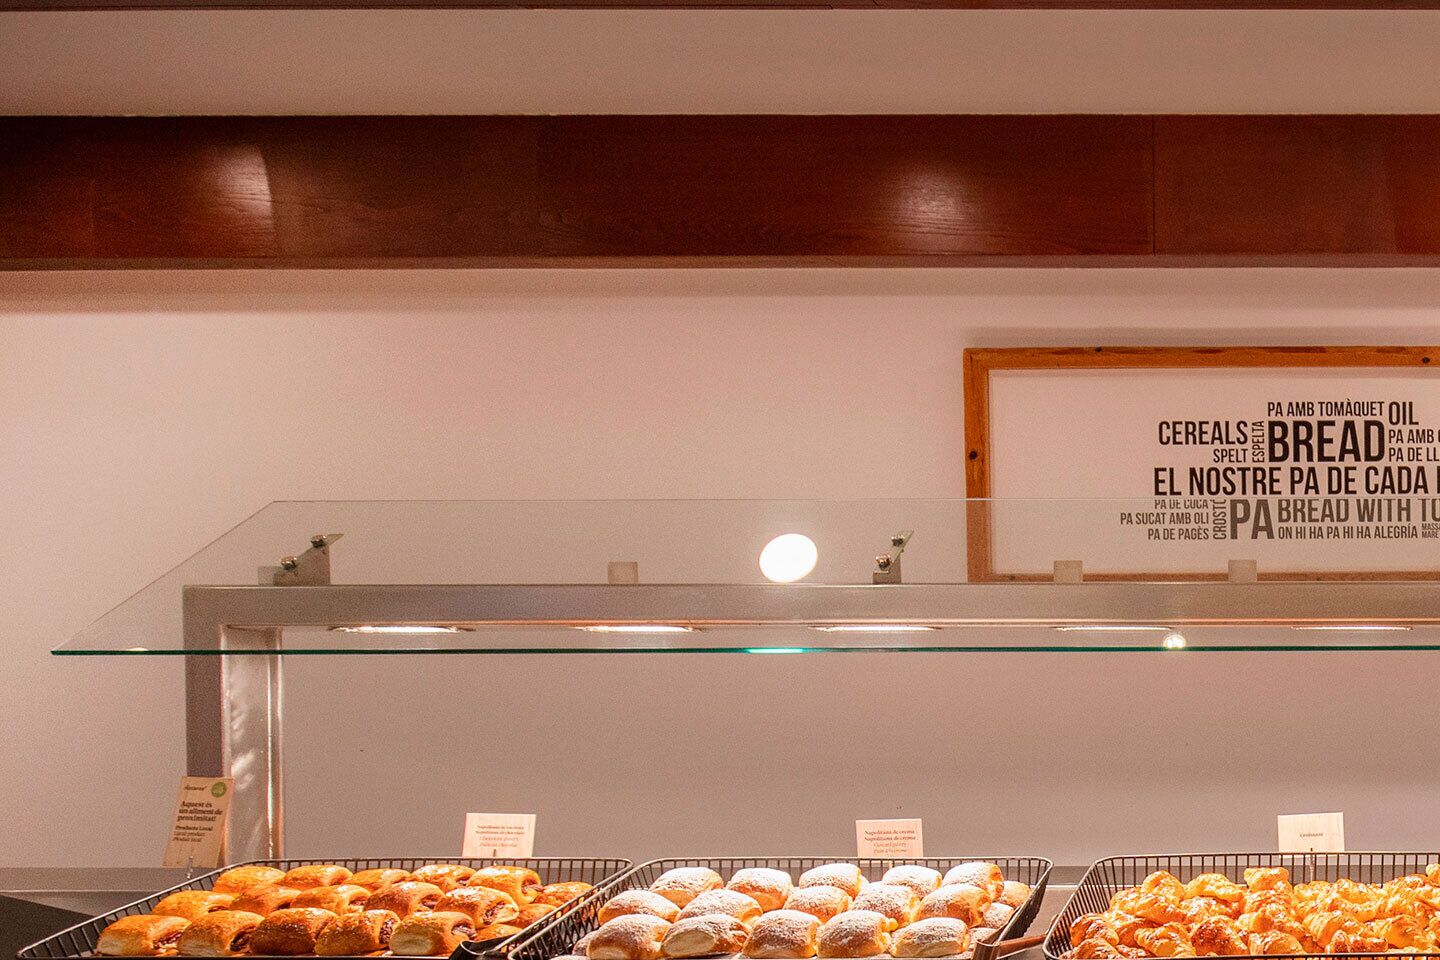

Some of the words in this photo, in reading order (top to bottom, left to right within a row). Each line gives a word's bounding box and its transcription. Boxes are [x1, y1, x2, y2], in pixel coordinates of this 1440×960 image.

[1268, 401, 1283, 417] PA
[1287, 401, 1315, 417] AMB
[1317, 399, 1385, 417] TOMÀQUET
[1389, 401, 1419, 425] OIL
[1158, 421, 1248, 445] CEREALS
[1252, 421, 1265, 463] ESPELTA
[1268, 420, 1385, 462] BREAD
[1389, 429, 1404, 444] PA
[1407, 429, 1434, 444] AMB
[1213, 449, 1248, 463] SPELT
[1389, 447, 1404, 462] PA
[1407, 447, 1422, 462] DE
[1154, 467, 1182, 496] EL
[1189, 467, 1282, 496] NOSTRE
[1290, 467, 1320, 495] PA
[1328, 466, 1357, 494] DE
[1365, 466, 1428, 494] CADA
[1120, 512, 1133, 525] PA
[1135, 512, 1166, 525] SUCAT
[1169, 512, 1191, 525] AMB
[1194, 512, 1209, 525] OLI
[1230, 499, 1275, 540] PA
[1278, 499, 1349, 523] BREAD
[1356, 499, 1411, 523] WITH
[1148, 528, 1160, 540] PA
[1163, 528, 1175, 540] DE
[1178, 525, 1209, 540] PAGÈS
[1278, 526, 1292, 539] ON
[1296, 526, 1306, 539] HI
[1309, 526, 1324, 539] HA
[1327, 526, 1340, 539] PA
[1343, 526, 1353, 539] HI
[1356, 526, 1371, 539] HA
[1374, 523, 1418, 539] ALEGRÍA
[1422, 531, 1439, 539] MARE
